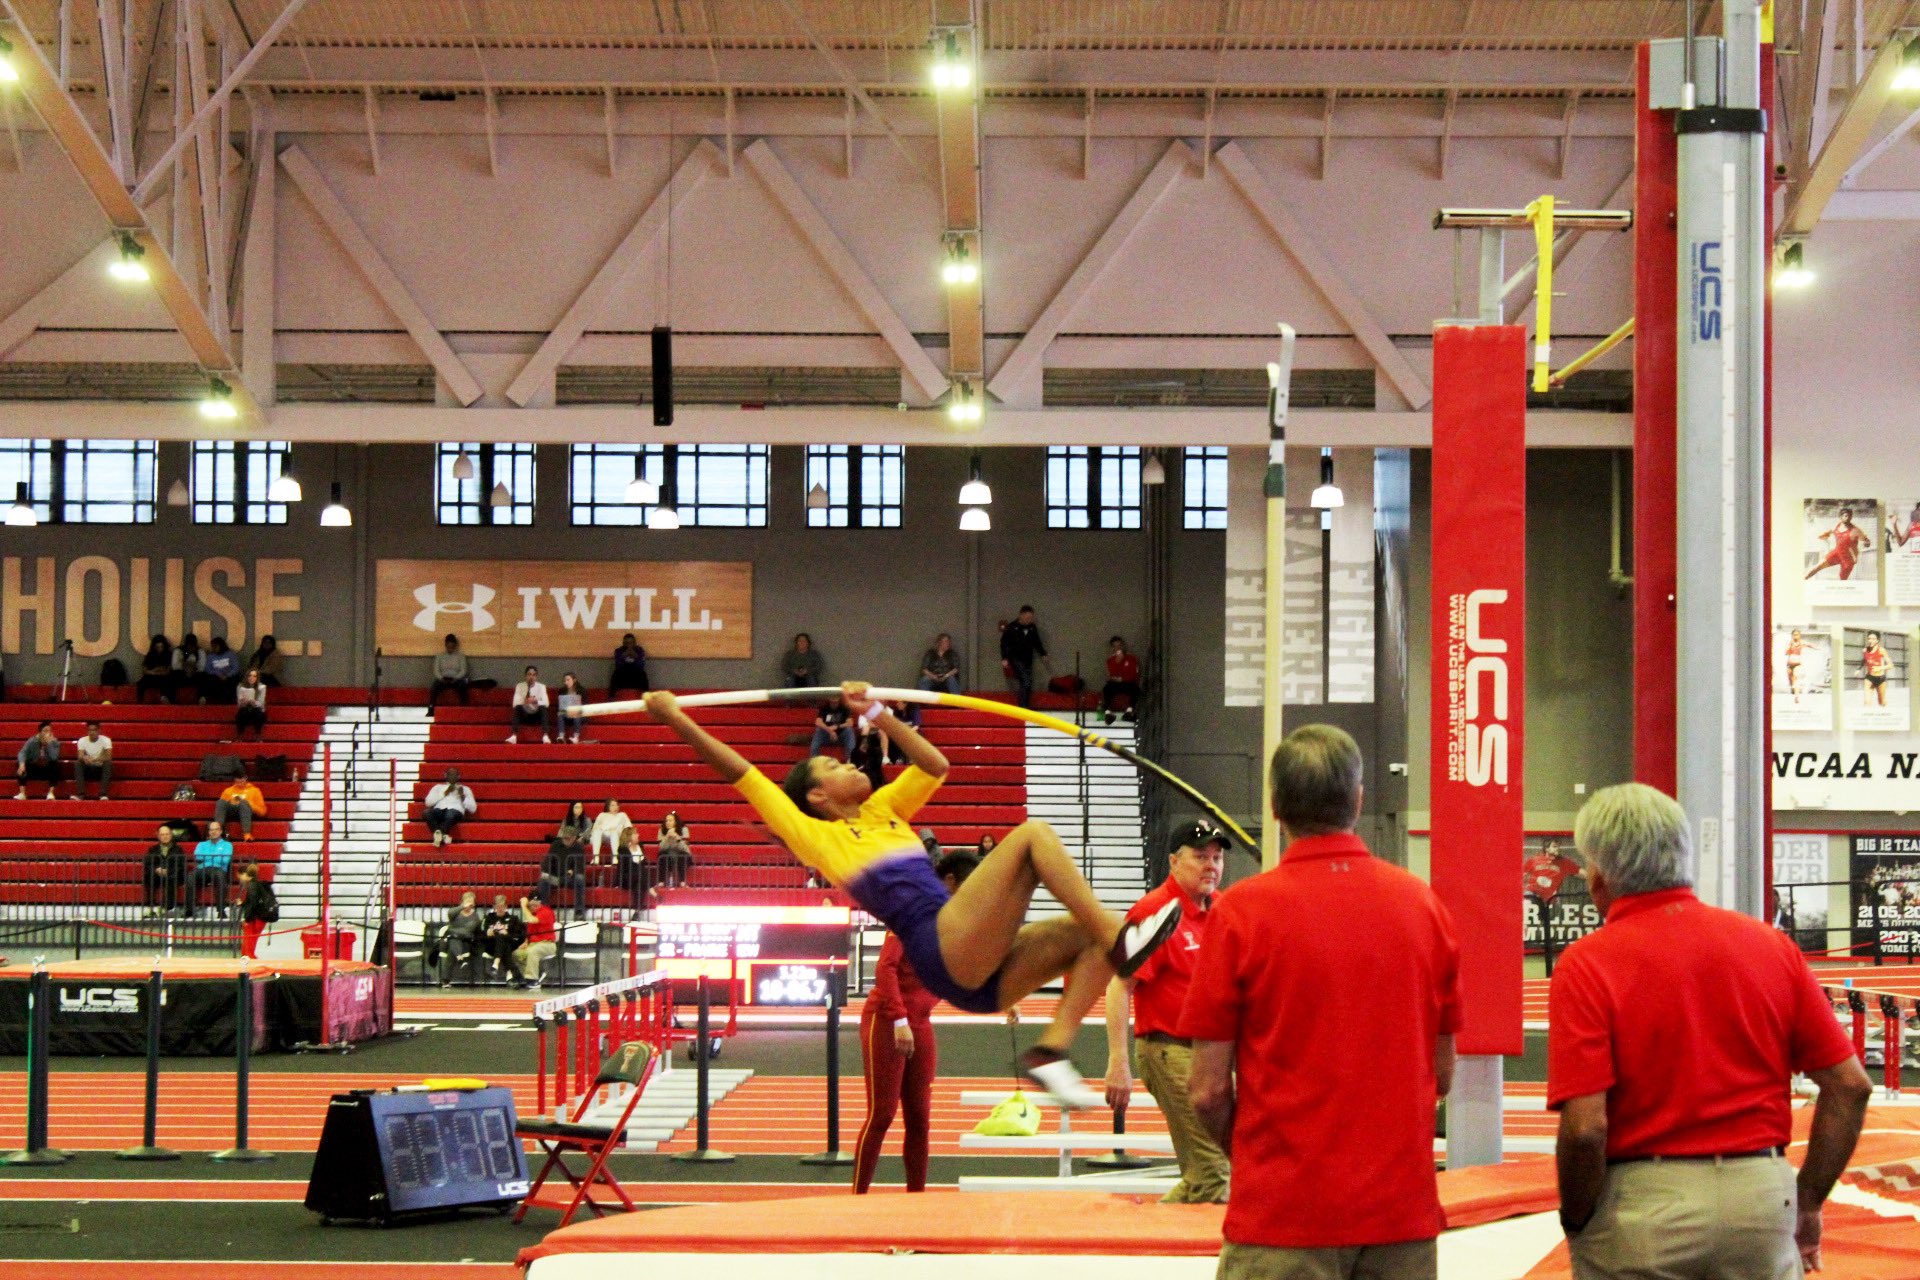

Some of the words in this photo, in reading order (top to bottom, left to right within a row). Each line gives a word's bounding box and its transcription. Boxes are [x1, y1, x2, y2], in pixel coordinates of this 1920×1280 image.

[1701, 242, 1720, 340] UCS
[2, 555, 322, 657] HOUSE.
[517, 587, 542, 629] I
[550, 587, 723, 630] WILL.
[1282, 507, 1323, 705] RAIDERS
[1329, 560, 1375, 703] FIGHT
[1466, 589, 1508, 786] UCS
[1887, 753, 1920, 779] N
[1856, 839, 1876, 851] BIG
[1880, 839, 1892, 851] 12
[1894, 839, 1920, 852] TEA
[60, 987, 138, 1006] UCS
[497, 1180, 530, 1196] UCS
